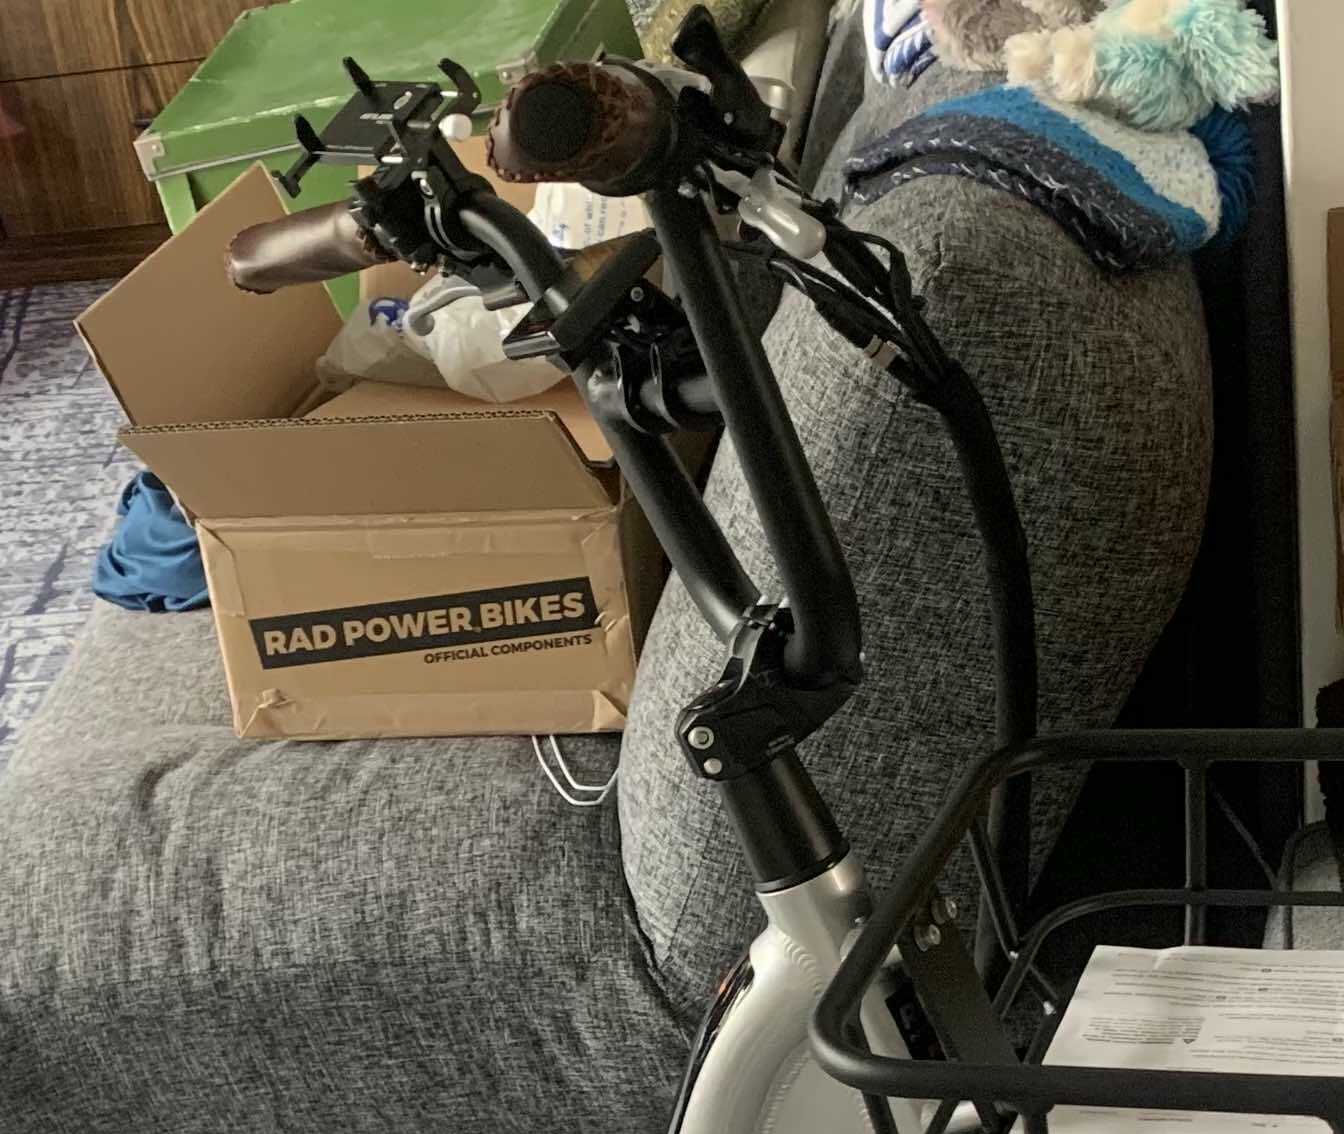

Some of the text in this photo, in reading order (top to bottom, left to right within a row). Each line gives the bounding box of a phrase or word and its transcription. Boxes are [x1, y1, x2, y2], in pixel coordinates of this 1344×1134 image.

[263, 591, 585, 657] RAD POWER BIKES
[423, 634, 593, 665] OFFICIAL COMPONENTS
